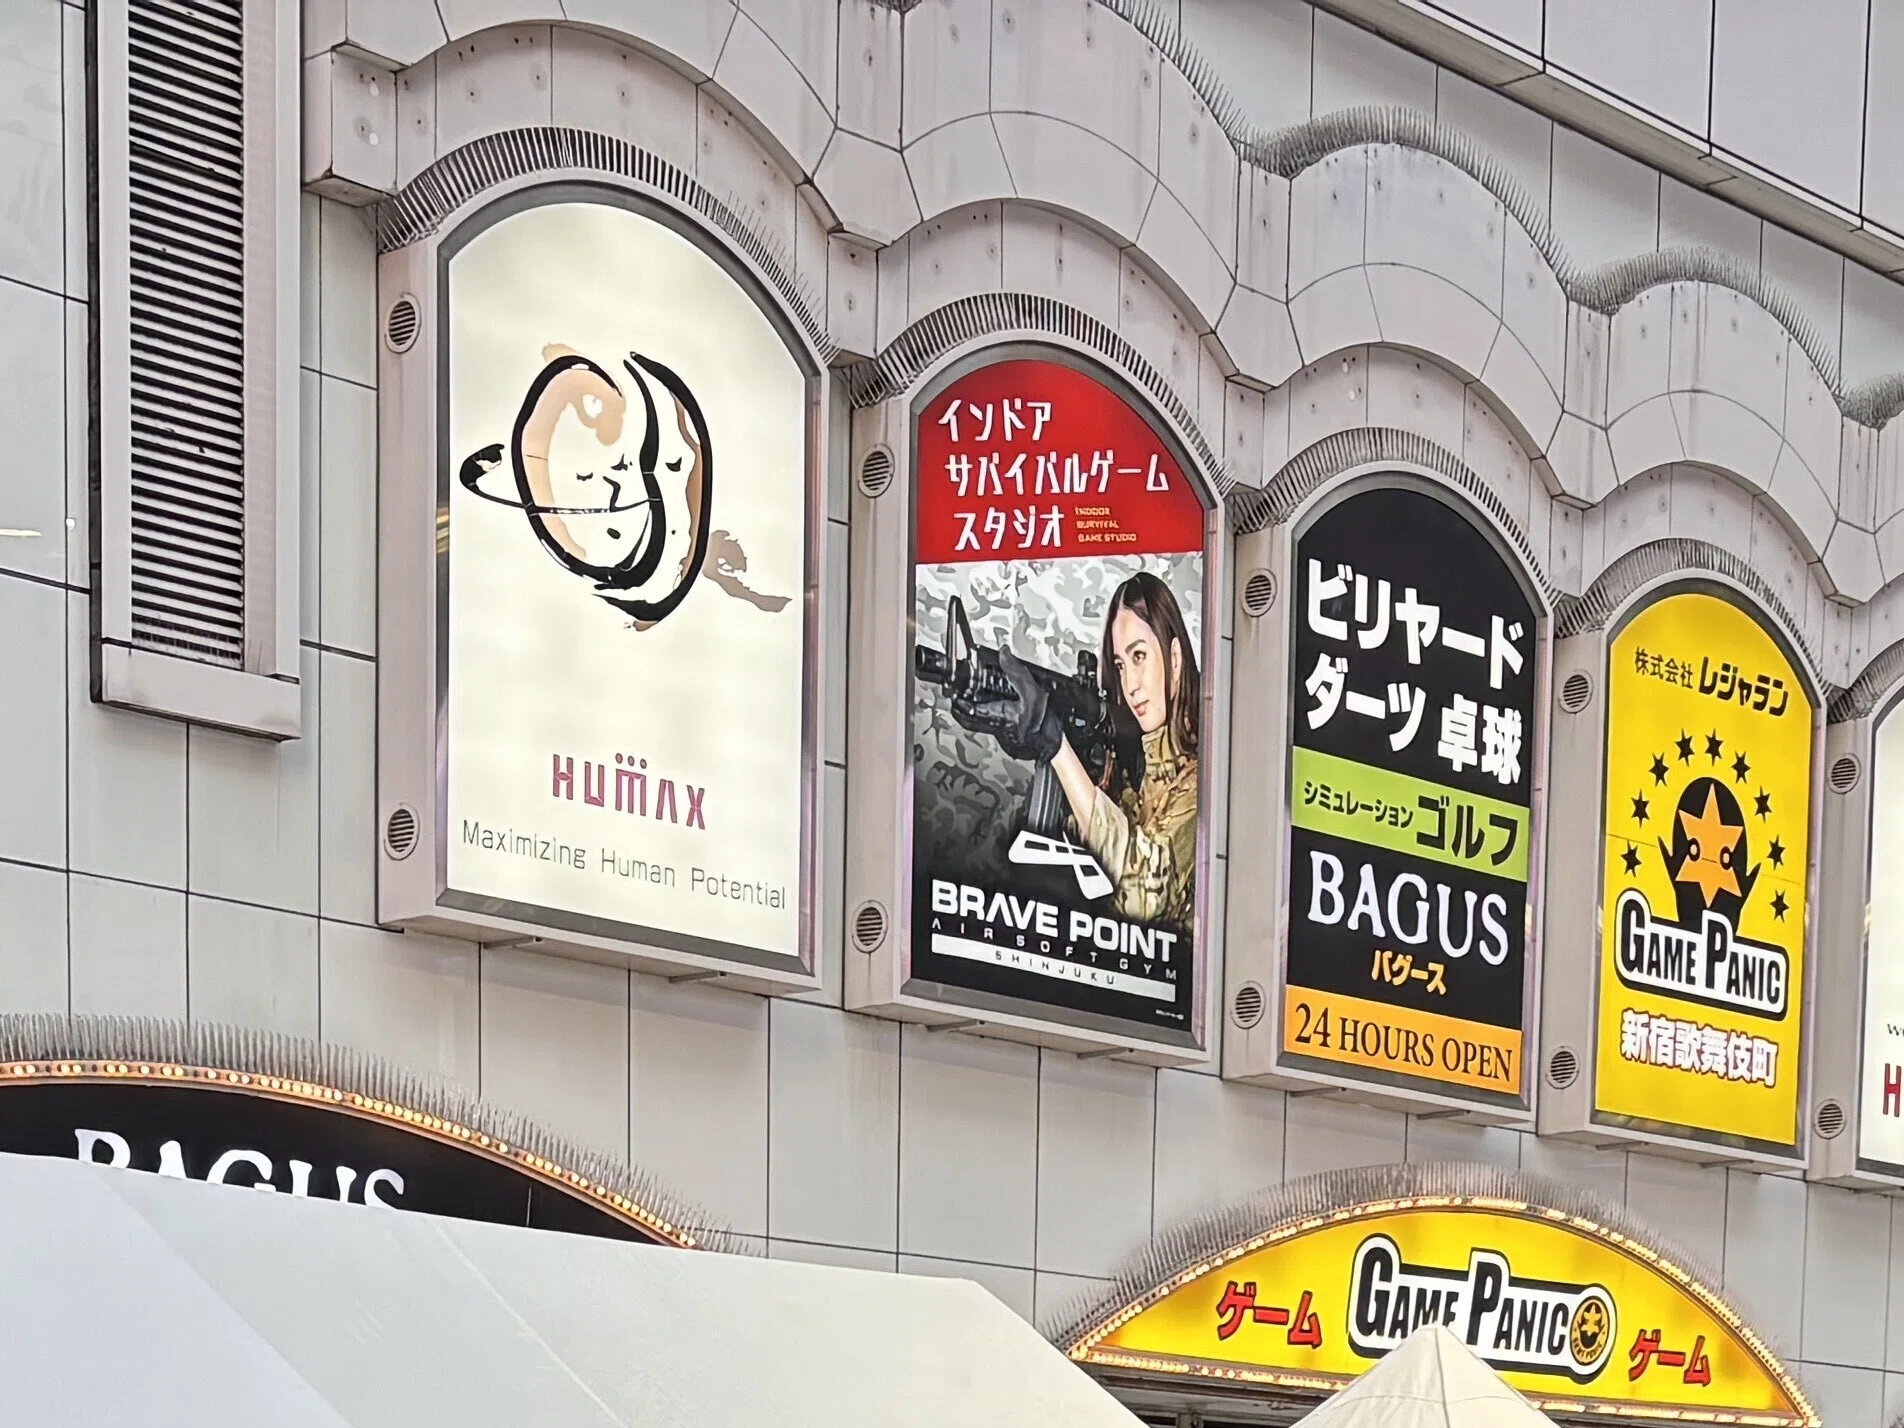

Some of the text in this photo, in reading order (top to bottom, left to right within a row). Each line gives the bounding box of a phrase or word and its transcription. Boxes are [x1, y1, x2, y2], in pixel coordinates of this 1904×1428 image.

[938, 398, 1052, 442] インドア
[944, 450, 1170, 497] サバイバルゲーム
[953, 505, 1065, 551] スタジオ
[1307, 558, 1525, 690] ビリヤード
[1305, 653, 1523, 785] ダーツ 卓球
[1634, 647, 1789, 717] 株式会社 レジャラン
[552, 752, 706, 830] HUMAX
[1303, 781, 1519, 866] シミュレーション ゴルフ
[462, 819, 786, 910] Maximizing Human Potential
[932, 879, 1178, 963] BRAVE POINT
[1307, 850, 1509, 966] BAGUS
[995, 950, 1116, 985] SHINJUKU
[1370, 949, 1447, 996] バグース
[1621, 897, 1782, 1006] GAME PANIC
[1294, 1002, 1513, 1082] 24 HOURS OPEN
[1619, 1008, 1779, 1088] 新宿歌舞伎町
[1216, 1281, 1323, 1350] ゲーム
[1356, 1246, 1569, 1357] GAME PANIC
[1628, 1327, 1711, 1388] ゲーム
